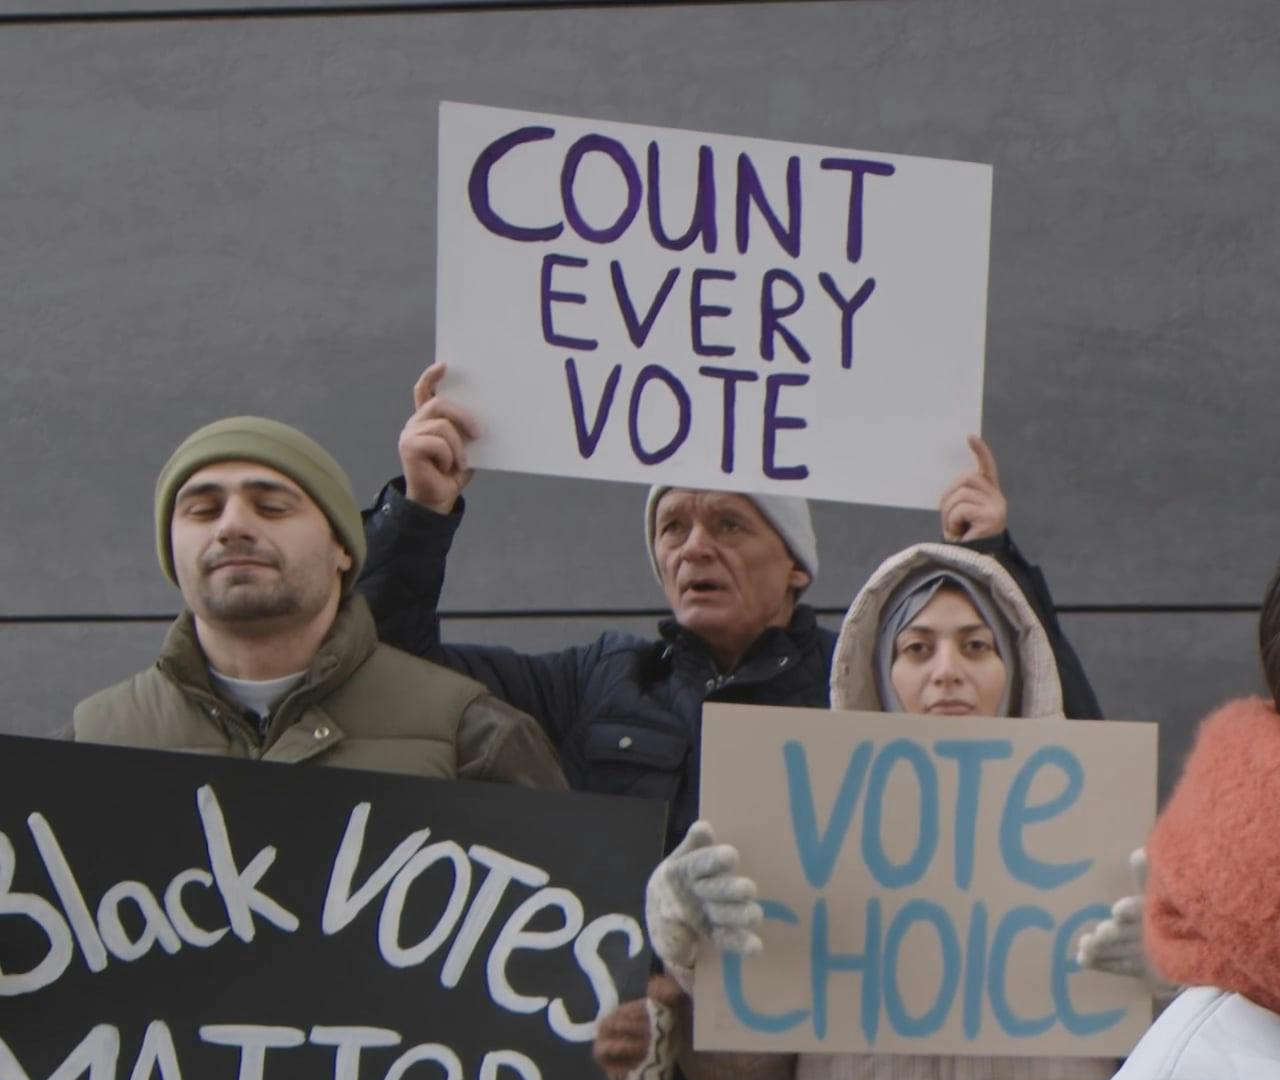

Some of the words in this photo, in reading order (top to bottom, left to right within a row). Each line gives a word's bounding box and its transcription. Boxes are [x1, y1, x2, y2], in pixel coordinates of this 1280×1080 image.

[467, 125, 896, 263] COUNT
[540, 252, 876, 369] EVERY
[564, 356, 810, 480] VOTE
